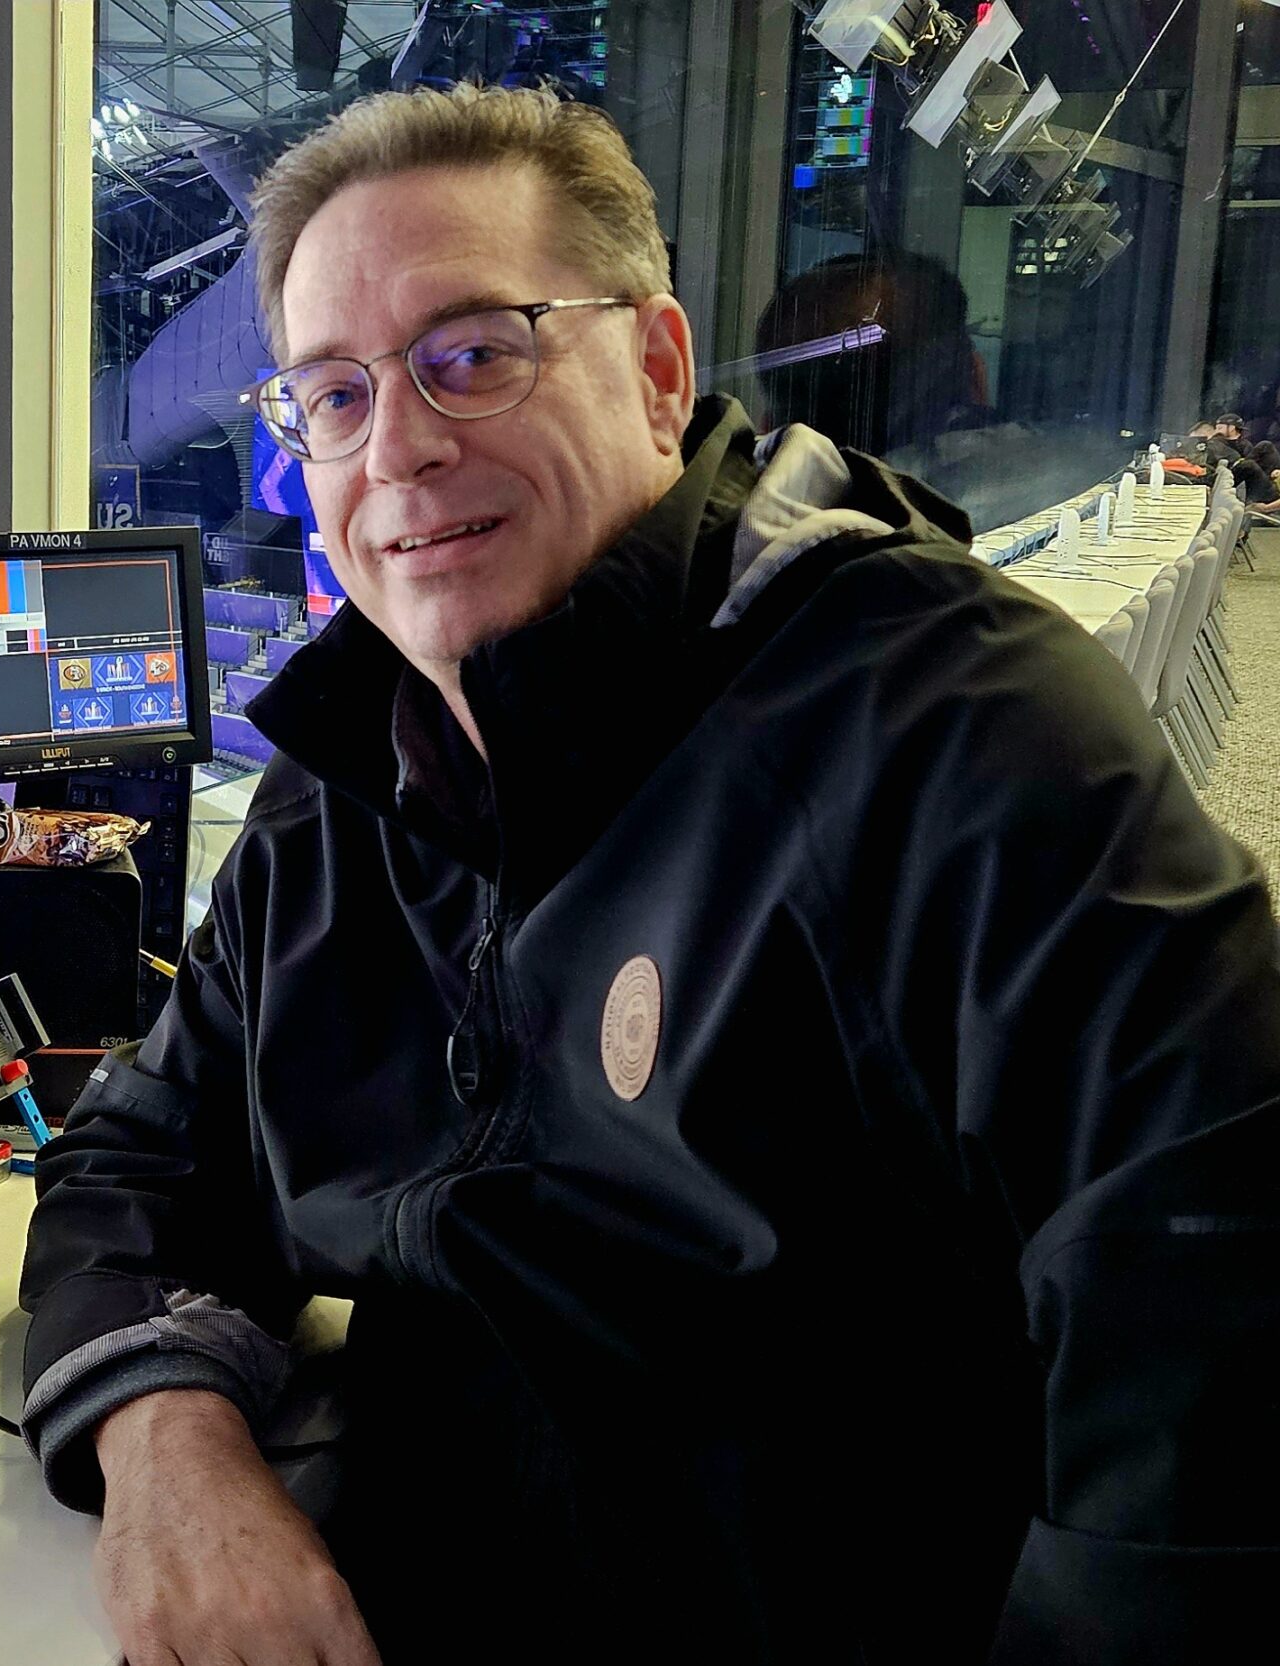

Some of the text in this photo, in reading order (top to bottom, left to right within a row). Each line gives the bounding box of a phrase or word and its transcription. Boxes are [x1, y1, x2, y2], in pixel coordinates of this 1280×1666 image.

[9, 533, 82, 549] PA VMON 4
[41, 747, 71, 759] LILLIPUT
